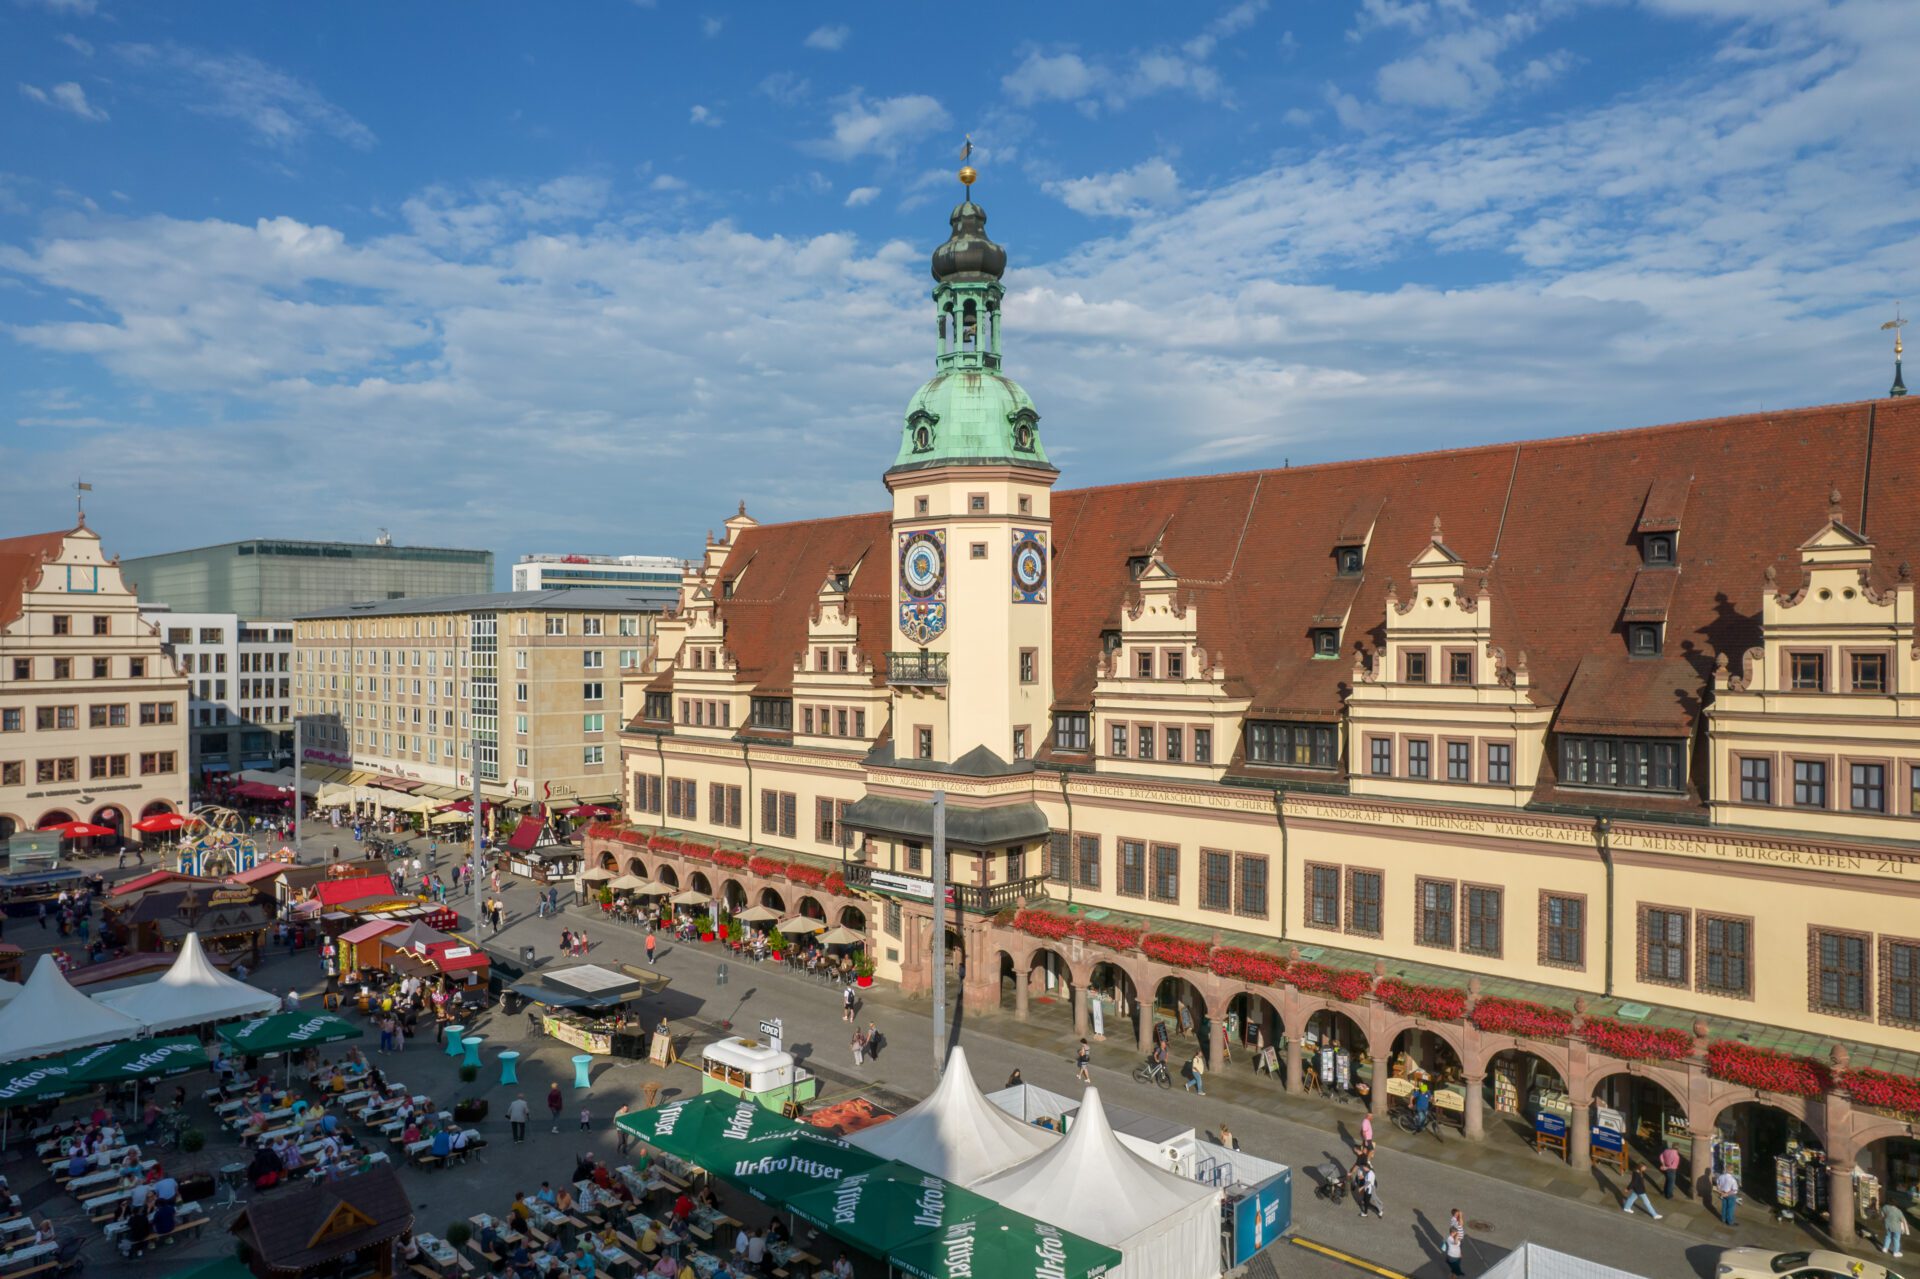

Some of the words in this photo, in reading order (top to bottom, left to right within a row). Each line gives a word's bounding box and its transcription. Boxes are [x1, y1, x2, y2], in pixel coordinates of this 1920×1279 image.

[1208, 798, 1231, 807] UND
[1235, 800, 1308, 815] CHURFUSTEN
[1316, 807, 1383, 823] LANDGRAFF
[1392, 813, 1405, 824] IN
[1613, 835, 1633, 846] ZU
[1642, 838, 1707, 854] MEISSEN
[1736, 847, 1861, 870] BURGGRAFFEN
[1876, 860, 1904, 874] ZU
[760, 1024, 778, 1036] CIDER
